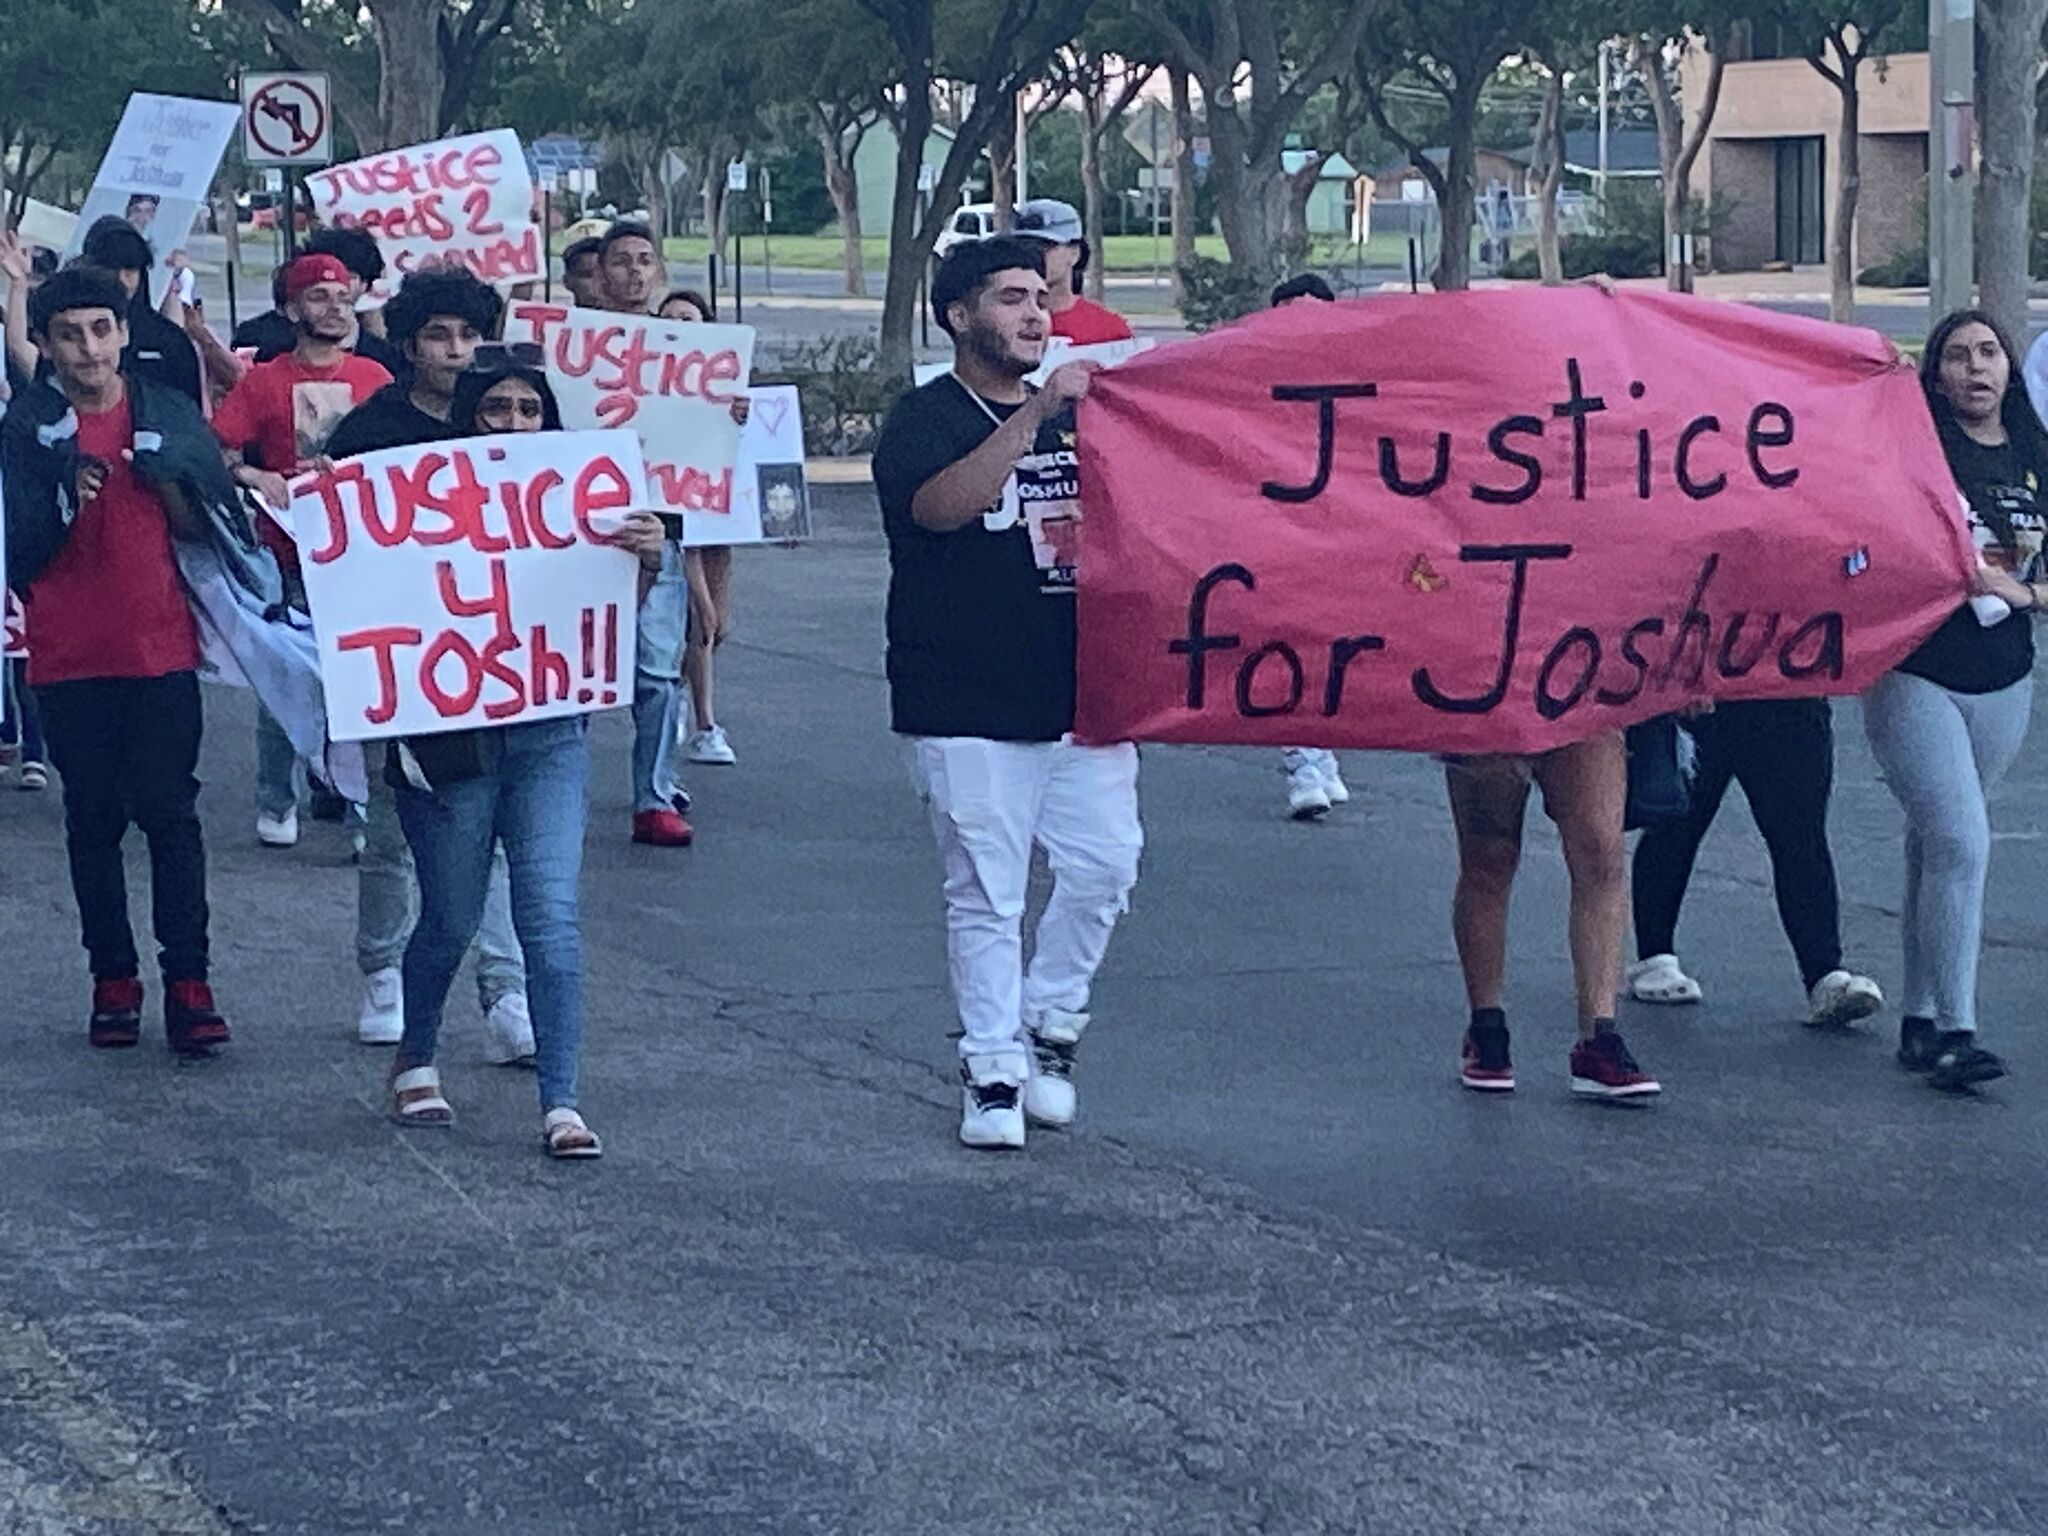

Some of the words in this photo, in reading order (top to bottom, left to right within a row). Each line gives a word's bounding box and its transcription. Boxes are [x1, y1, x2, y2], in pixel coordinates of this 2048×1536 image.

[314, 143, 502, 207] Justice
[462, 188, 504, 236] 2
[514, 306, 741, 406] Justice
[1259, 357, 1800, 505] Justice
[294, 448, 634, 564] Justice
[1167, 562, 1386, 719] for
[1410, 543, 1847, 721] Joshua
